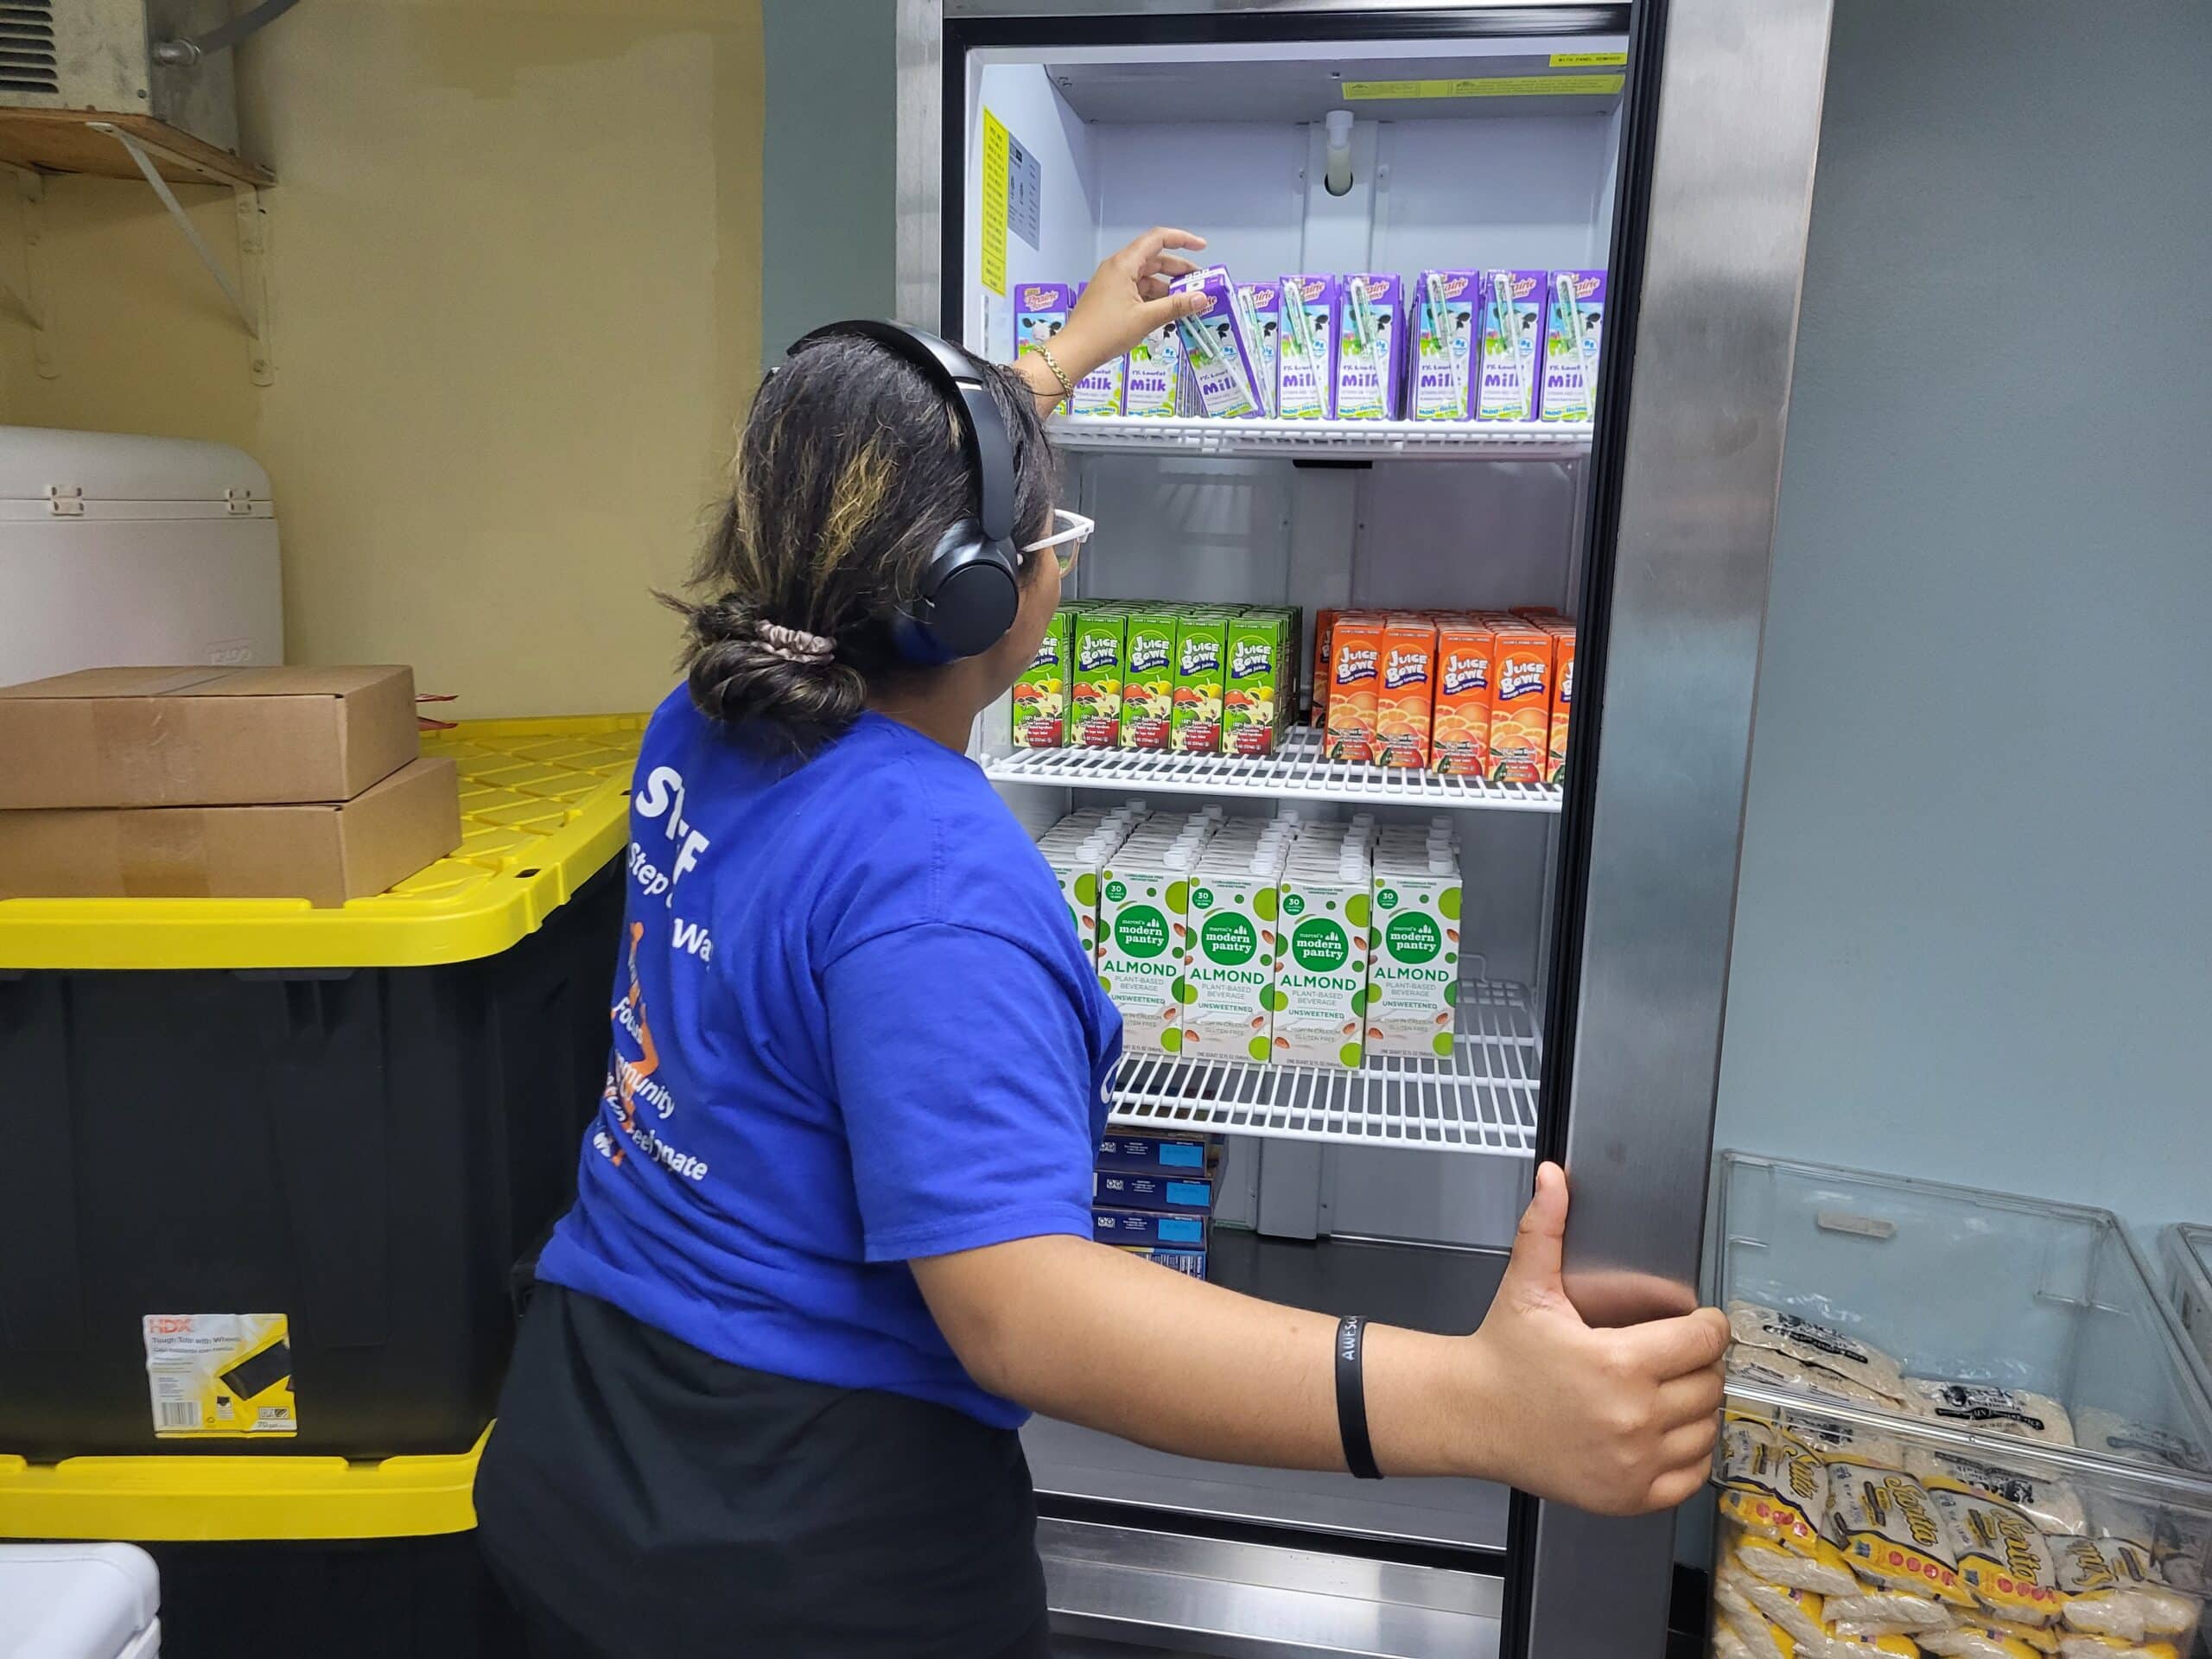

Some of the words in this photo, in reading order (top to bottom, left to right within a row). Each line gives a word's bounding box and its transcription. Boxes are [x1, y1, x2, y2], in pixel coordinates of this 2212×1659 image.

[1077, 378, 1112, 390] Milk
[1130, 378, 1166, 391] Milk
[628, 842, 669, 896] Step
[1119, 925, 1163, 937] modern
[1125, 934, 1165, 948] pantry
[1206, 932, 1250, 944] modern
[1390, 932, 1435, 943] modern
[1212, 942, 1252, 955] pantry
[1296, 939, 1342, 950] modern
[1396, 941, 1437, 953] pantry
[1303, 949, 1344, 961] pantry
[1103, 960, 1177, 977] ALMOND
[1190, 968, 1264, 985] ALMOND
[1374, 967, 1449, 982] ALMOND
[1115, 976, 1165, 986] PLANT-BASED
[1281, 975, 1357, 991] ALMOND
[1386, 982, 1437, 991] PLANT-BASED
[1120, 982, 1160, 992] BEVERAGE
[1202, 983, 1252, 994] PLANT-BASED
[1206, 990, 1246, 1000] BEVERAGE
[1292, 989, 1344, 1000] PLANT-BASED
[1391, 988, 1431, 998] BEVERAGE
[1111, 995, 1166, 1005] UNSWEETENED
[1298, 997, 1336, 1007] BEVERAGE
[1382, 1001, 1438, 1009] UNSWEETENED
[1198, 1002, 1254, 1013] UNSWEETENED
[1288, 1009, 1345, 1020] UNSWEETENED
[149, 1319, 193, 1333] HDX
